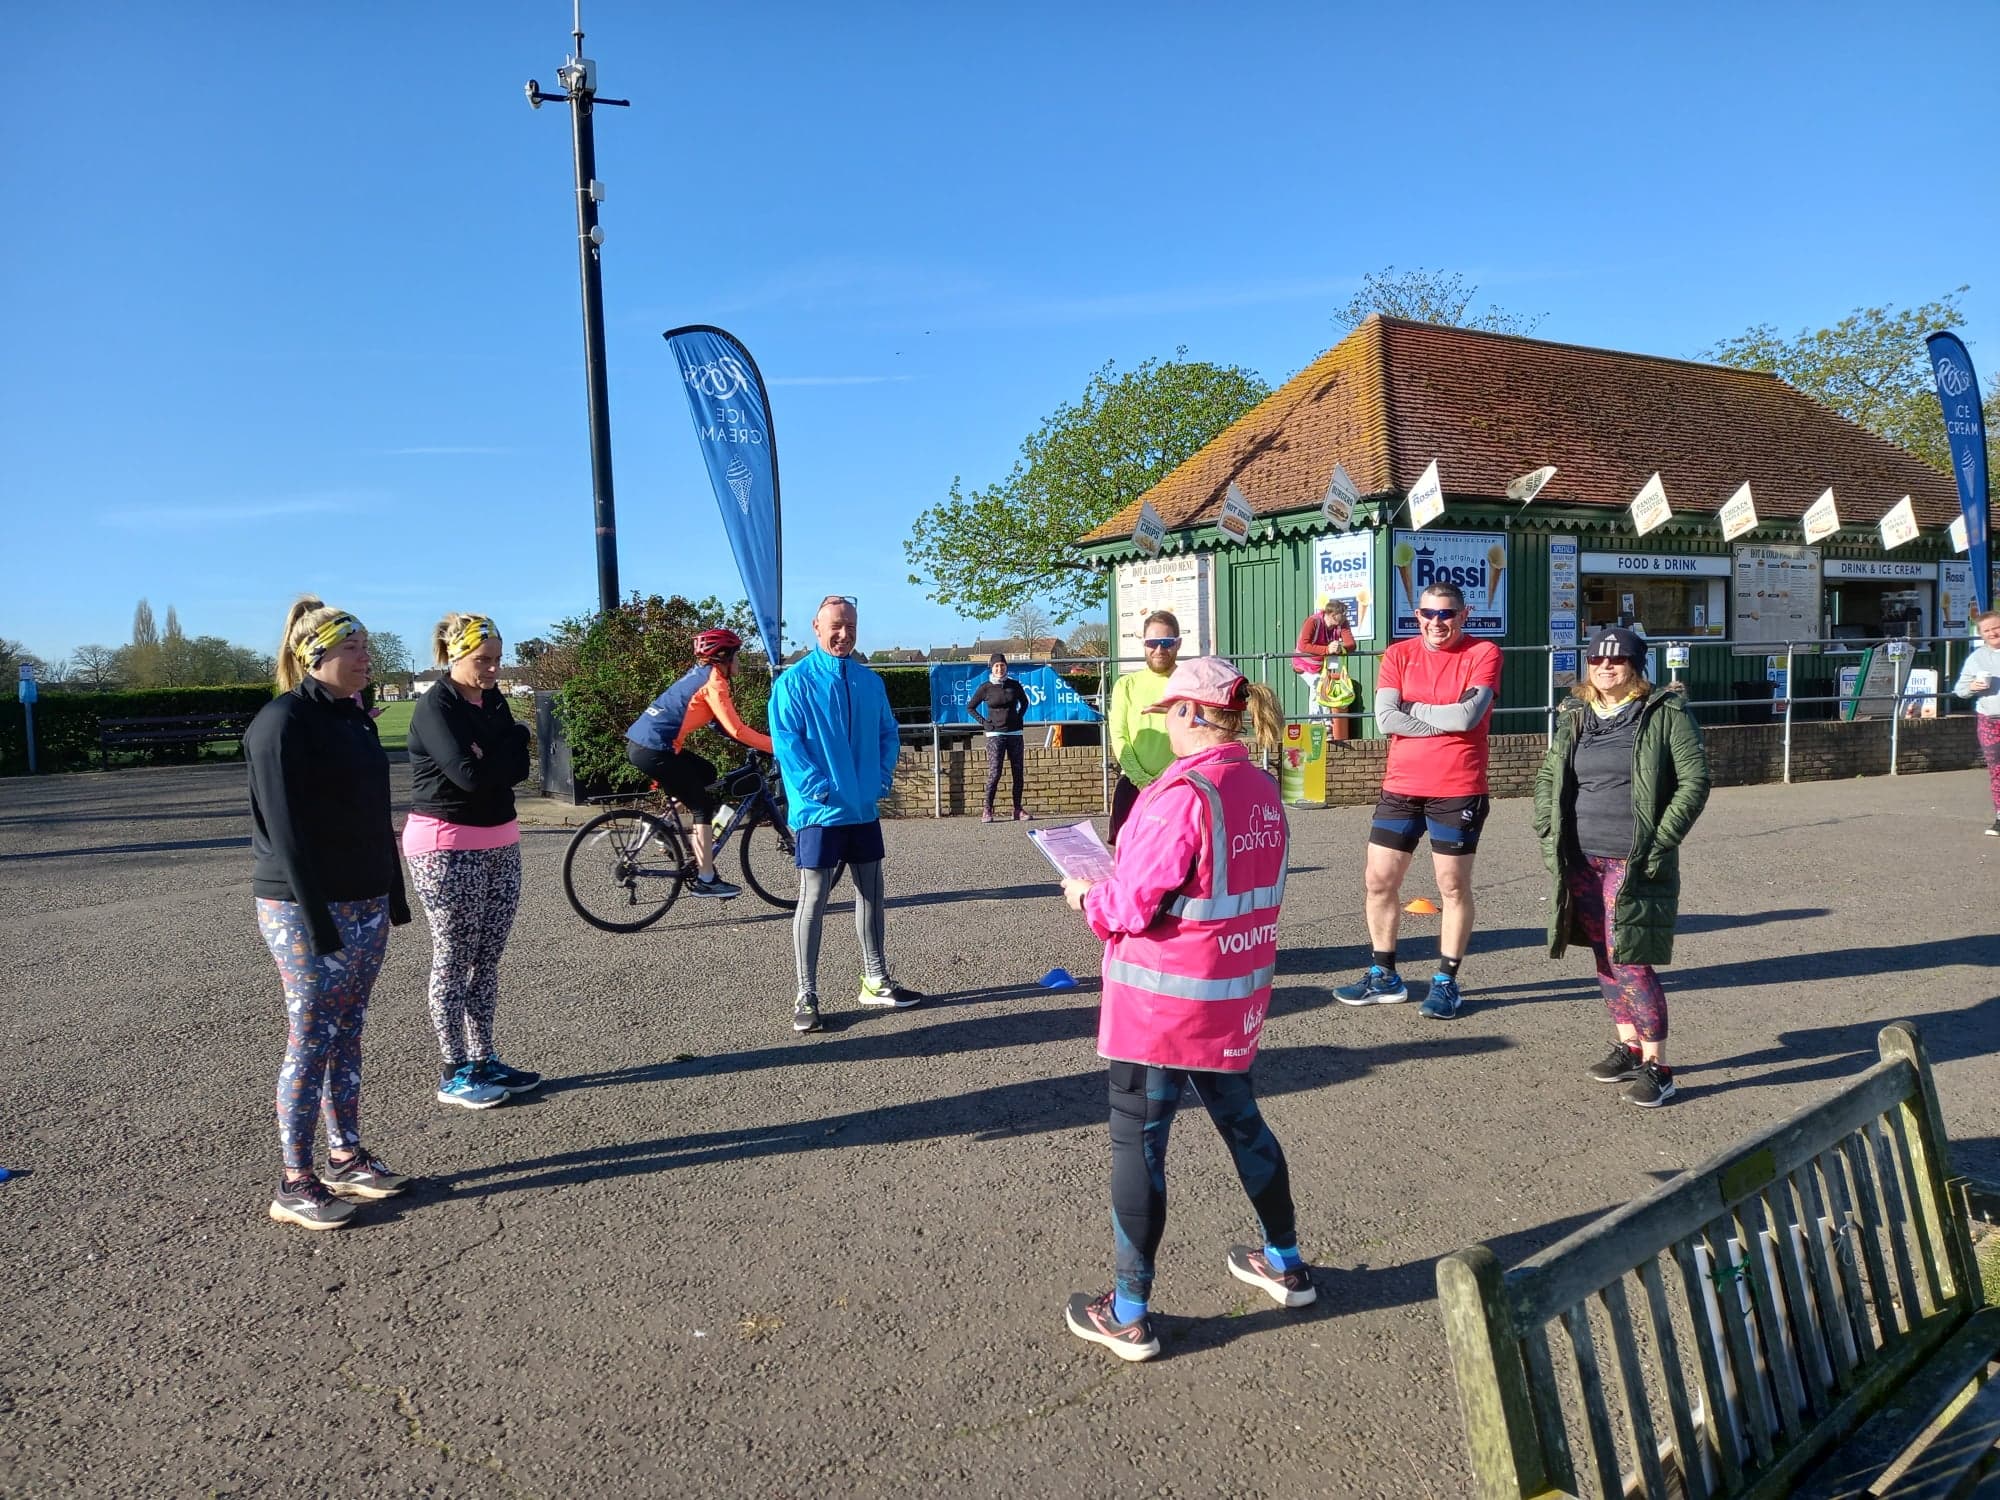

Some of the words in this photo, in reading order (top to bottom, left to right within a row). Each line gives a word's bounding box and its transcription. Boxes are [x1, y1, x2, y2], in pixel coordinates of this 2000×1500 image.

[1956, 405, 1970, 418] ICE
[1947, 421, 1979, 436] CREAM
[1226, 501, 1237, 514] HOT
[1140, 522, 1161, 540] CHIPS
[1320, 552, 1367, 575] Rossi
[1618, 557, 1649, 569] FOOD
[1653, 558, 1660, 570] &
[1664, 558, 1697, 571] DRINK
[1841, 563, 1867, 574] DRINK
[1870, 563, 1876, 574] &
[1879, 564, 1892, 575] ICE
[1894, 564, 1922, 576] CREAM
[1417, 558, 1486, 588] Rossi
[1945, 571, 1965, 583] Rossi
[1461, 590, 1486, 599] eam
[951, 680, 972, 691] ICE
[940, 694, 971, 706] CREA
[1232, 820, 1282, 859] parkrun
[1217, 924, 1277, 955] VOLUNTE
[1223, 1047, 1248, 1058] HEALTH
